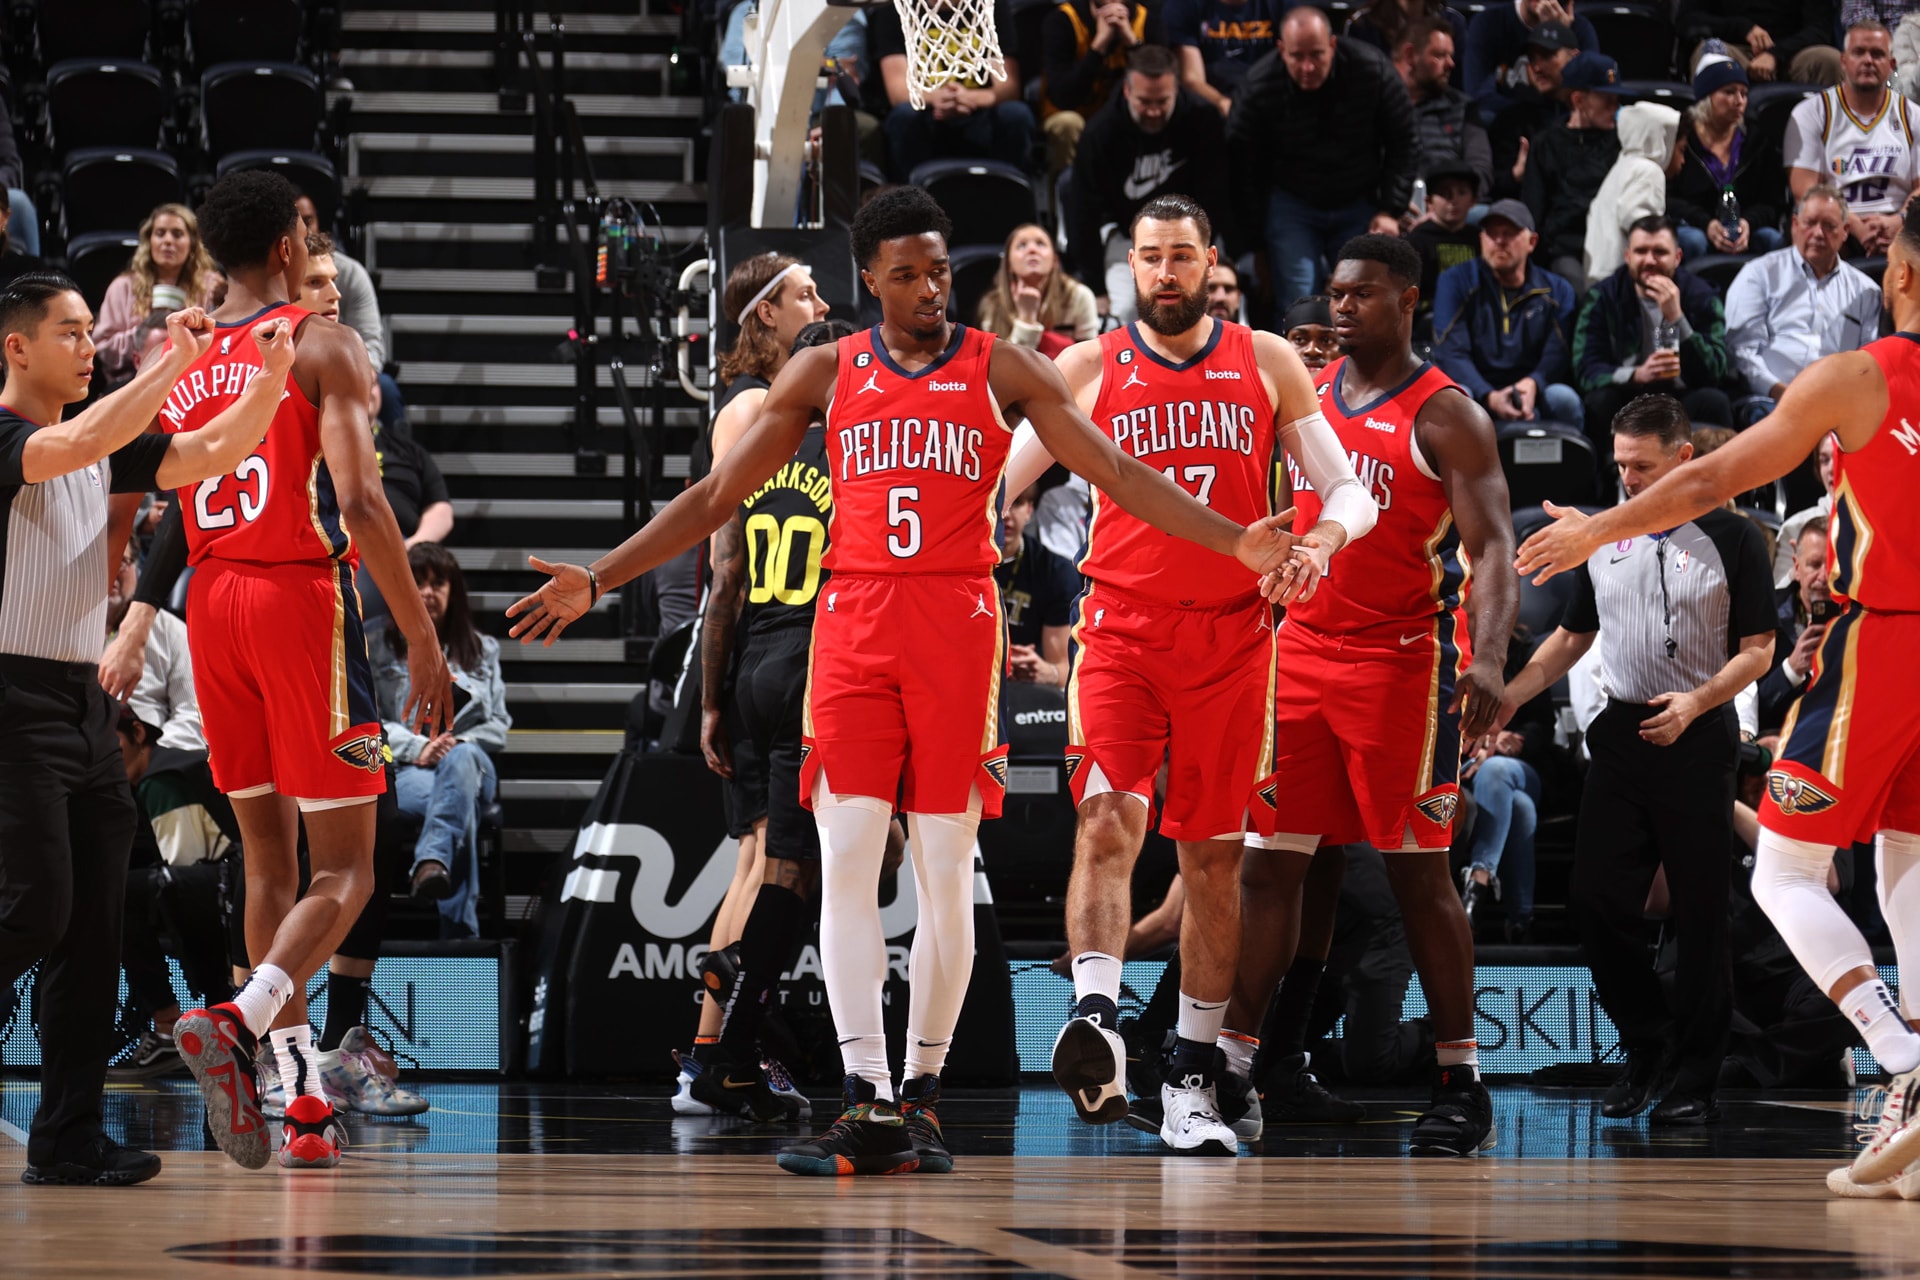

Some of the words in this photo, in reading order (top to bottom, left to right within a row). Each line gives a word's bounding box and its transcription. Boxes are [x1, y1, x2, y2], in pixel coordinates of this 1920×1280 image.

[1207, 21, 1273, 39] JAZZ
[857, 353, 869, 367] 6
[1120, 350, 1131, 363] 6
[1205, 369, 1241, 380] ibotta
[160, 362, 262, 430] MURPHY
[929, 380, 967, 392] ibotta
[1111, 401, 1256, 458] PELICANS
[1364, 417, 1396, 433] ibotta
[838, 417, 984, 482] PELICANS
[887, 486, 923, 559] 5
[745, 513, 826, 606] 00
[1474, 986, 1597, 1051] SKI
